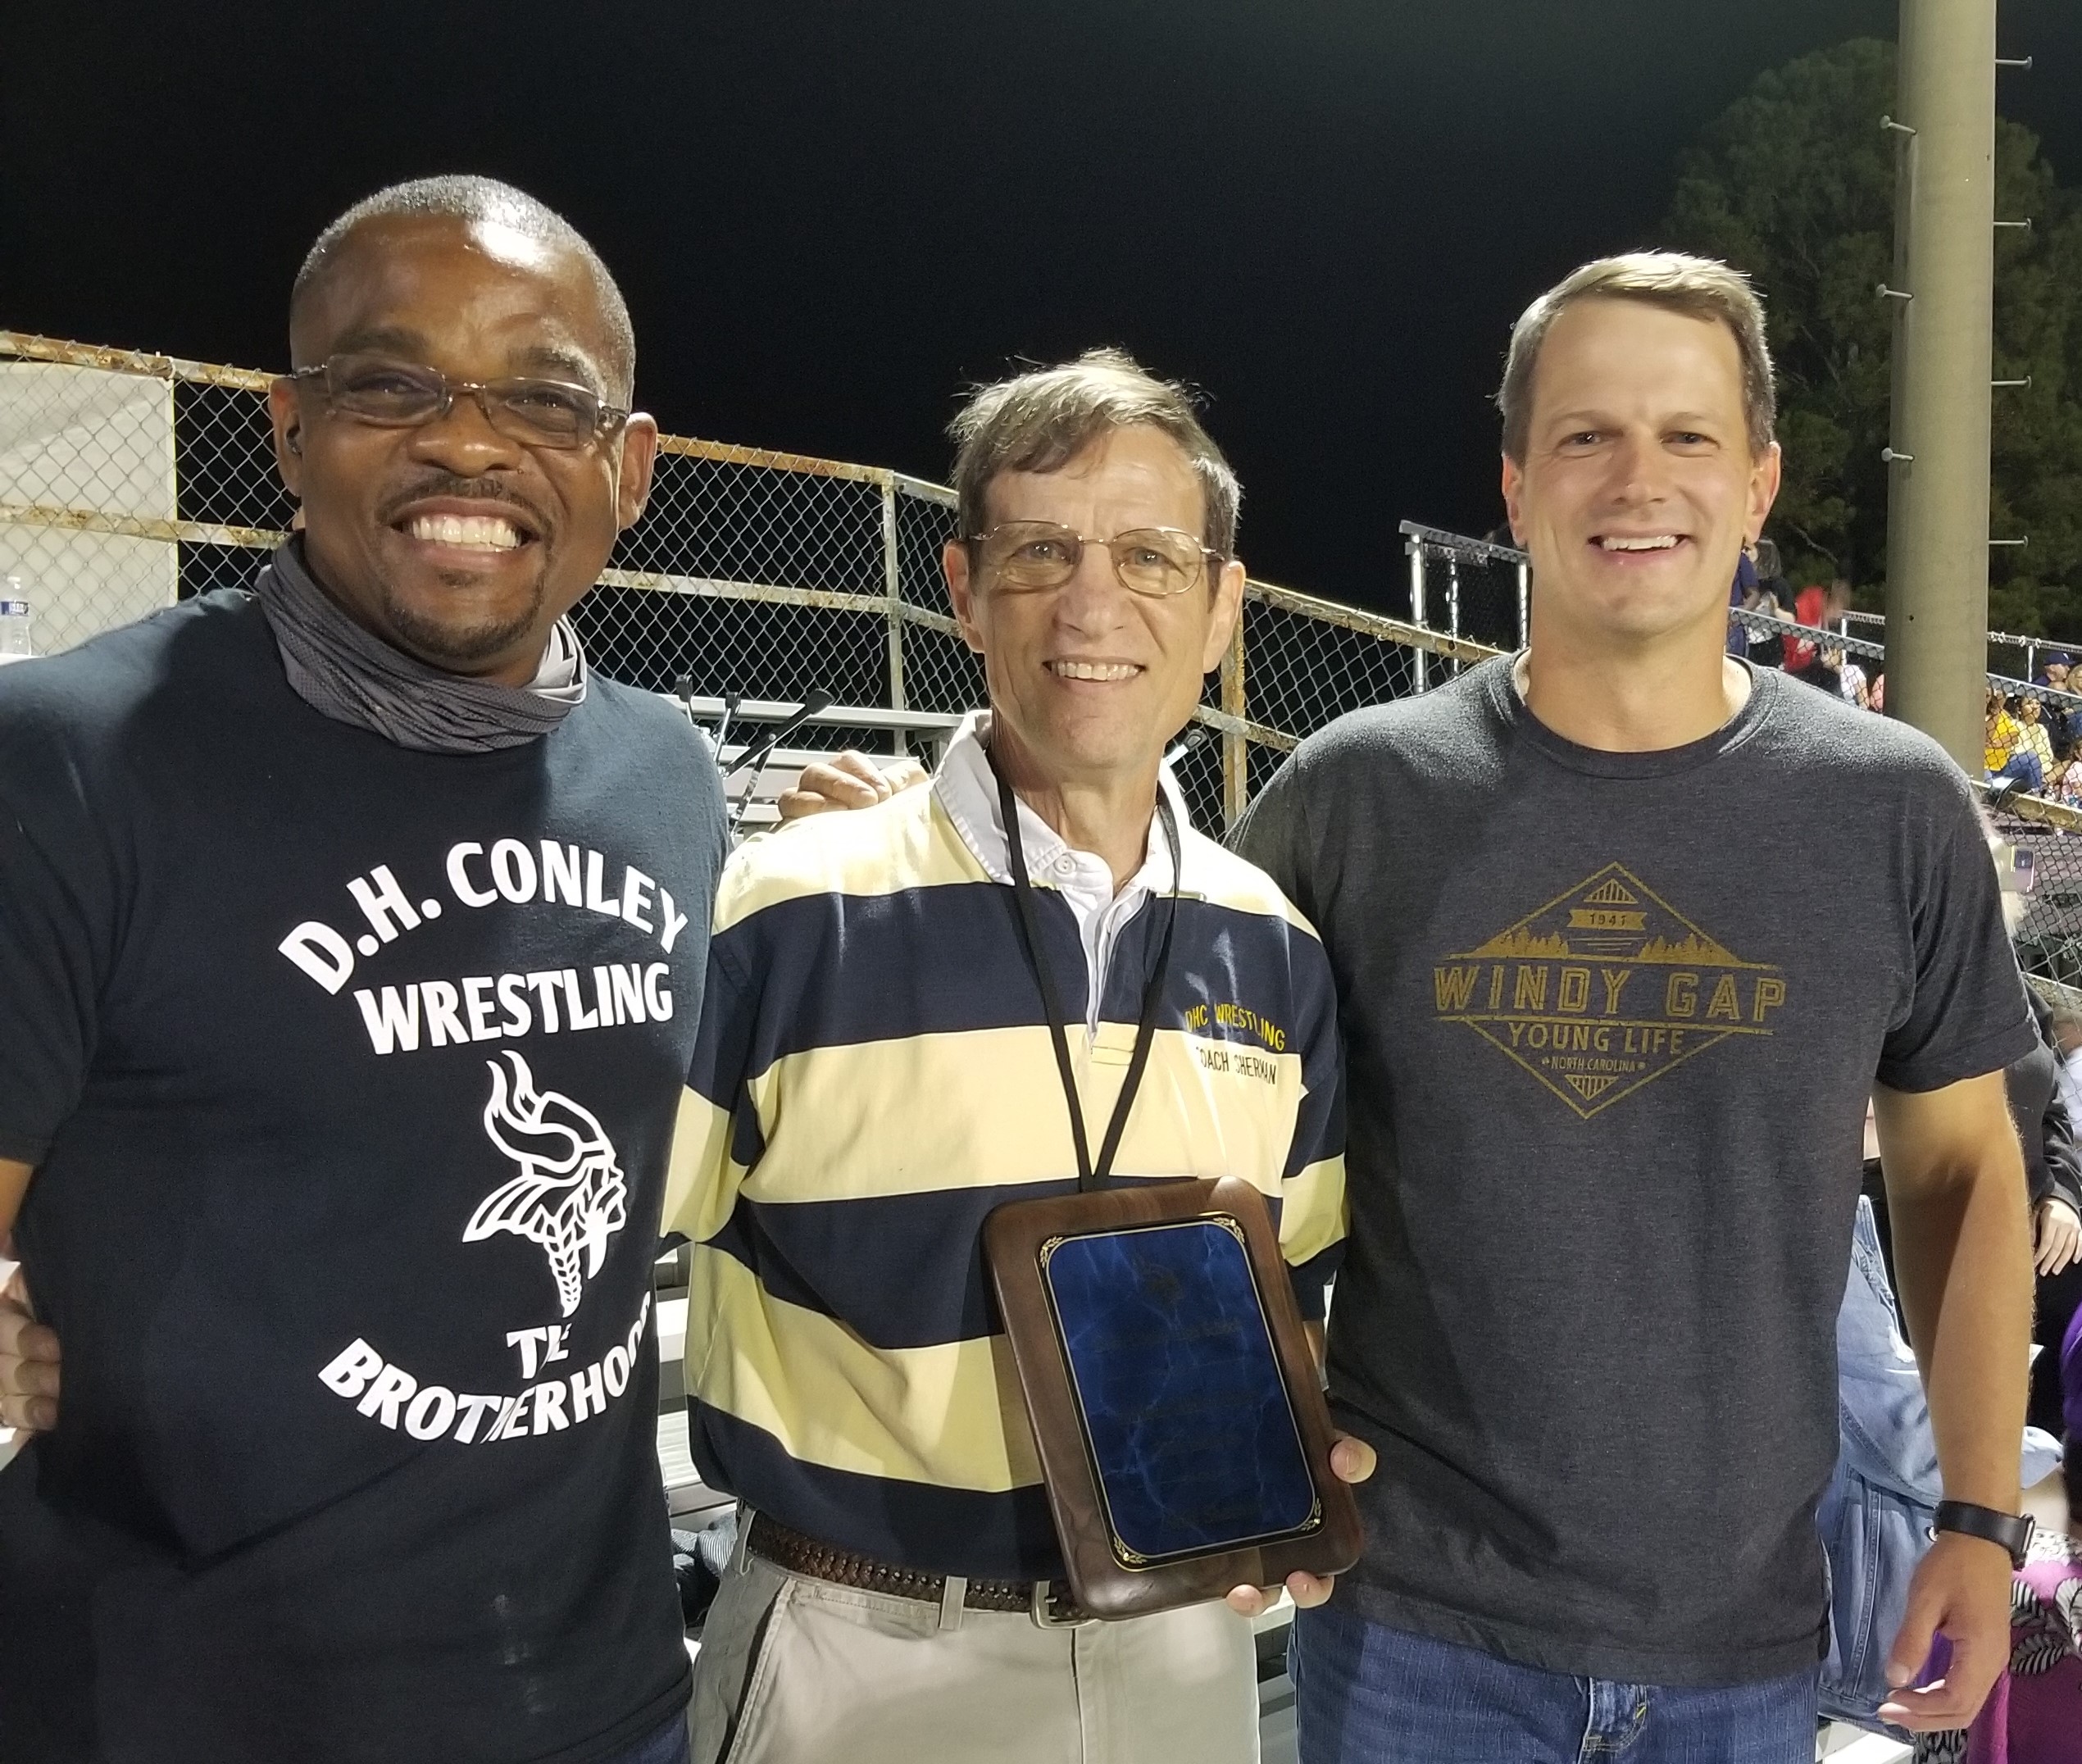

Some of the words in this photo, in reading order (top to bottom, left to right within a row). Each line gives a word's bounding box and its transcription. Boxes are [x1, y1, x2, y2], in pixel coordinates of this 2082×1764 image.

[278, 865, 443, 994] D.H.
[446, 839, 689, 954] CONLEY
[1590, 913, 1625, 926] 1941
[353, 962, 674, 1056] WRESTLING
[1434, 965, 1631, 1015] WINDY
[1666, 972, 1786, 1022] GAP
[1214, 1003, 1285, 1051] WRESTLING
[1508, 1022, 1610, 1052] YOUNG
[1625, 1027, 1685, 1055] LIFE
[1196, 1047, 1230, 1072] OACH
[1551, 1056, 1584, 1071] NORTH
[1587, 1058, 1636, 1073] CAROLINA
[506, 1322, 572, 1380] TE
